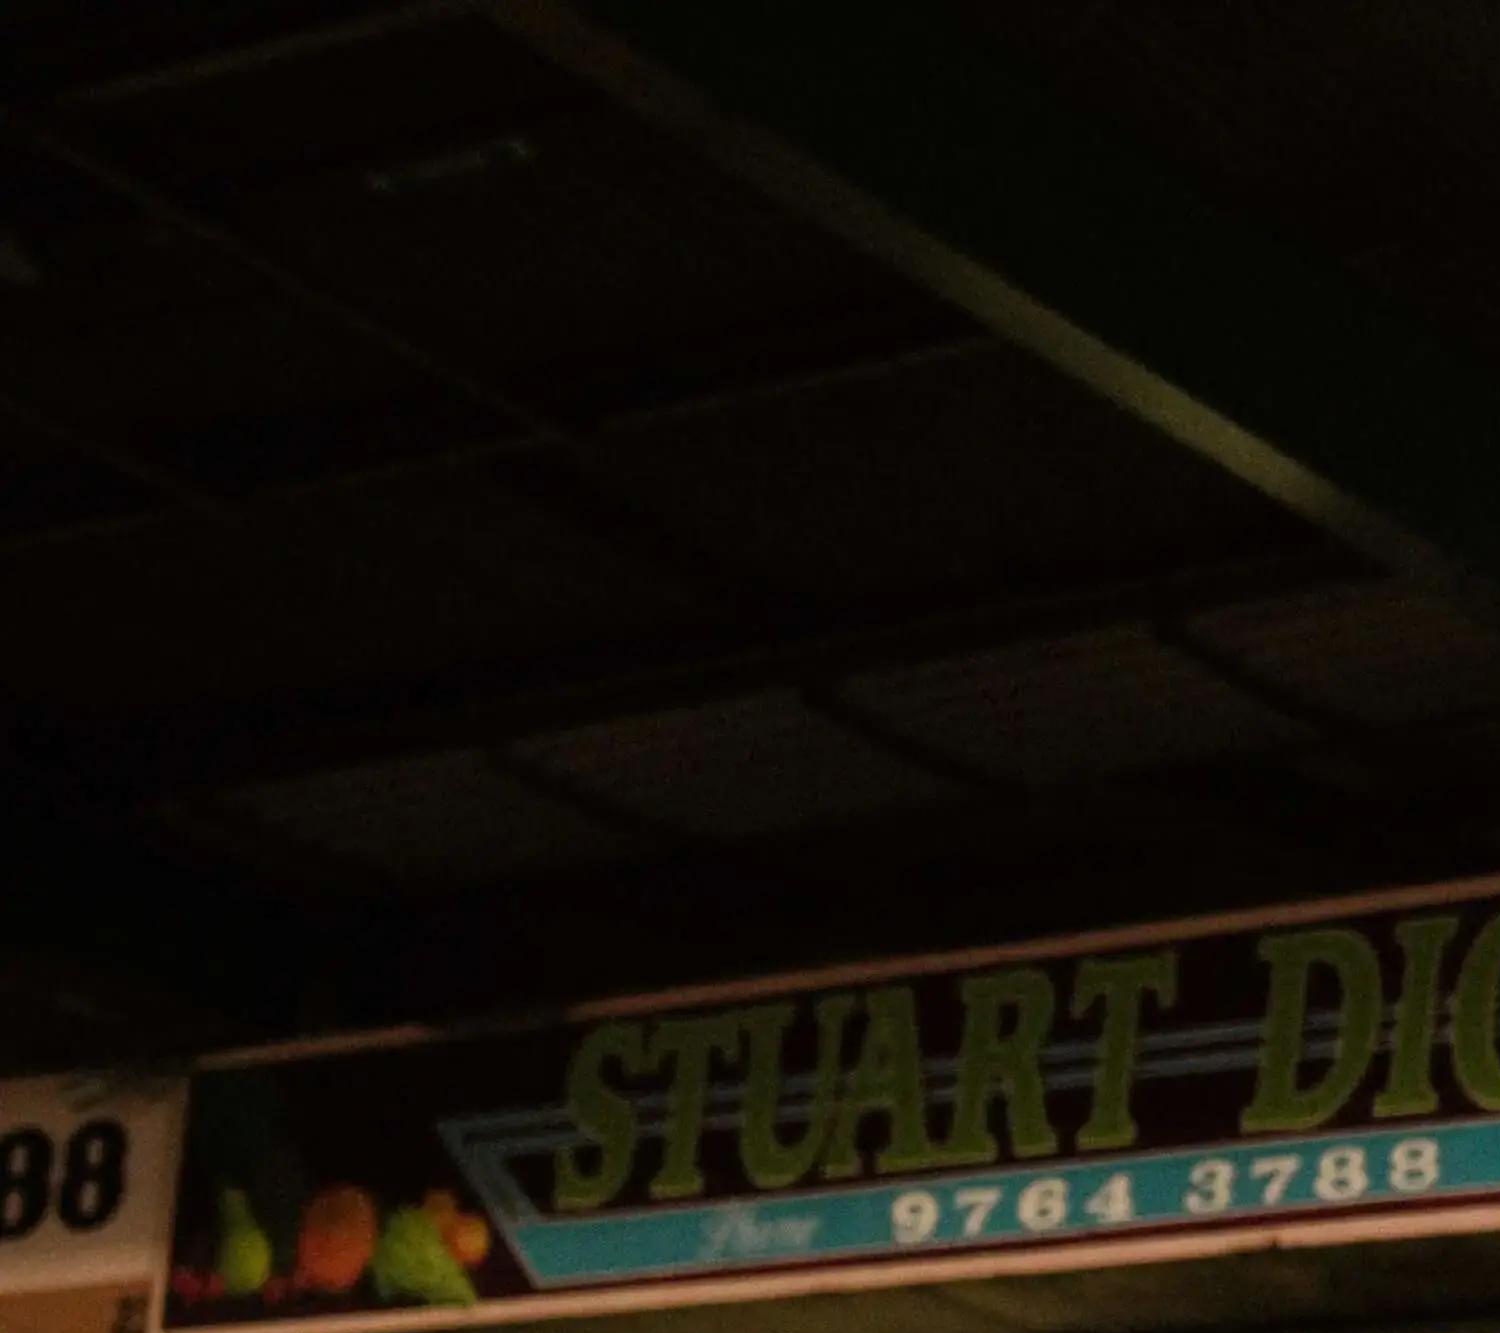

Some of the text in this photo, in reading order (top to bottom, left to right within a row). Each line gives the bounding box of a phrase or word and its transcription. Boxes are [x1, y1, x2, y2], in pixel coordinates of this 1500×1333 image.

[553, 950, 1178, 1210] STUART
[890, 1172, 1136, 1247] 9764
[1184, 1137, 1440, 1215] 3788
